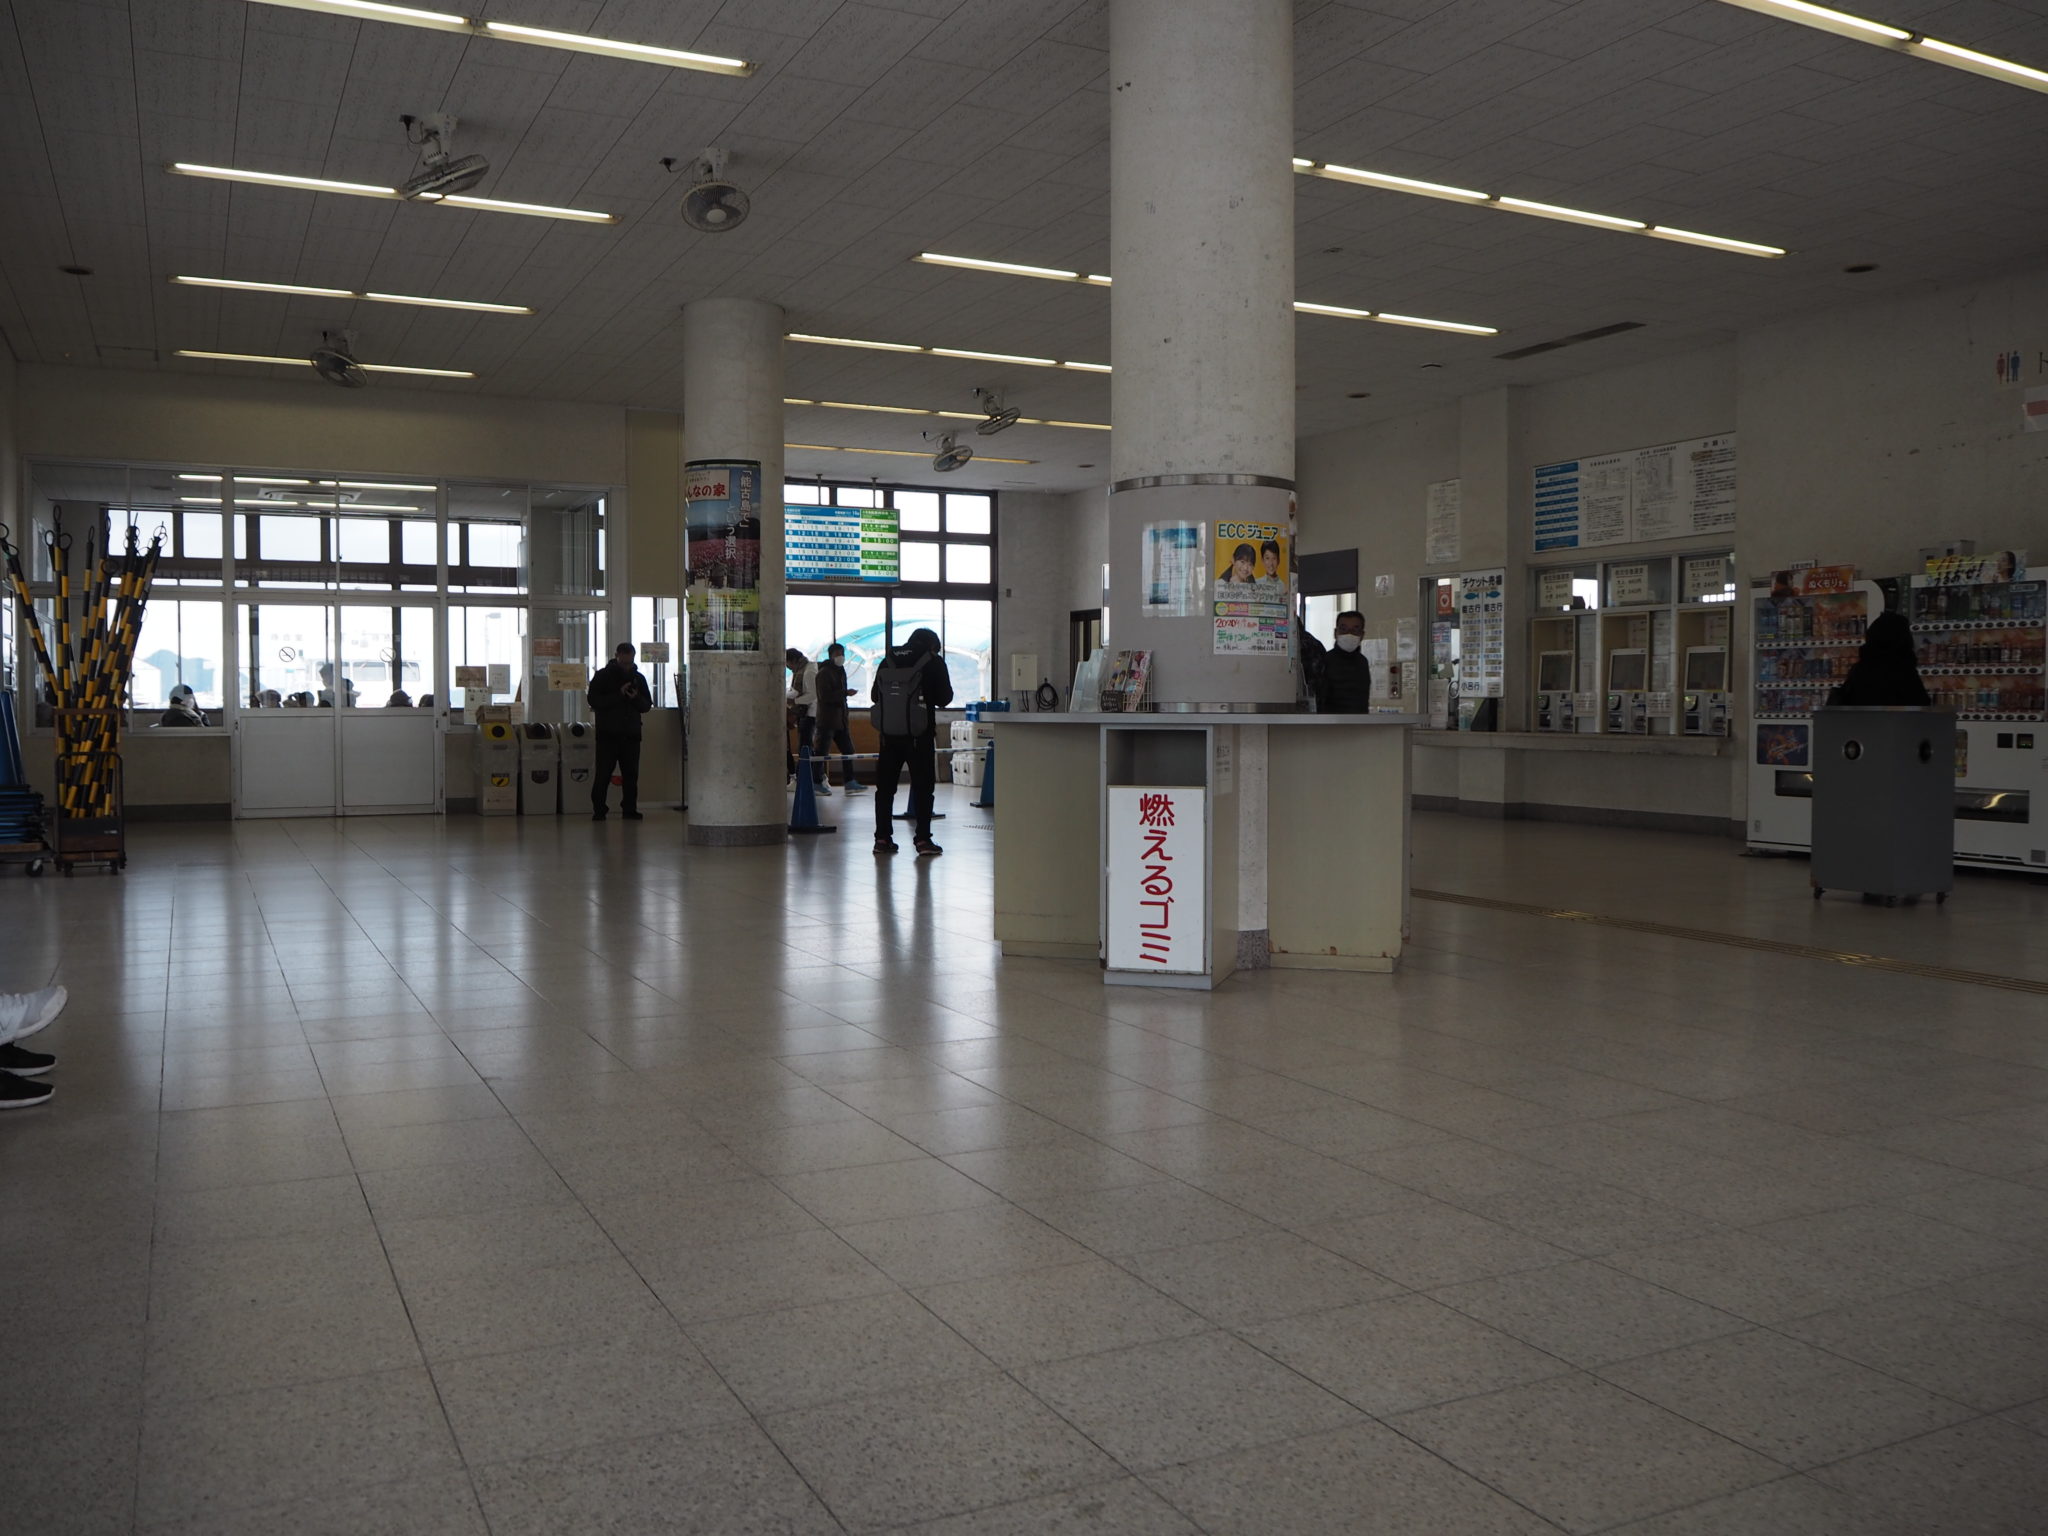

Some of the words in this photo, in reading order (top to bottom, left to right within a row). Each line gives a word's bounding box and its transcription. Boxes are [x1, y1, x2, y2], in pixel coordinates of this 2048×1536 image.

[739, 470, 752, 528] 「能古島で」
[725, 504, 737, 559] という選択
[1217, 523, 1279, 539] ECCジュニア
[1462, 575, 1502, 588] チケット売場
[1139, 793, 1175, 964] 燃えるゴミ
